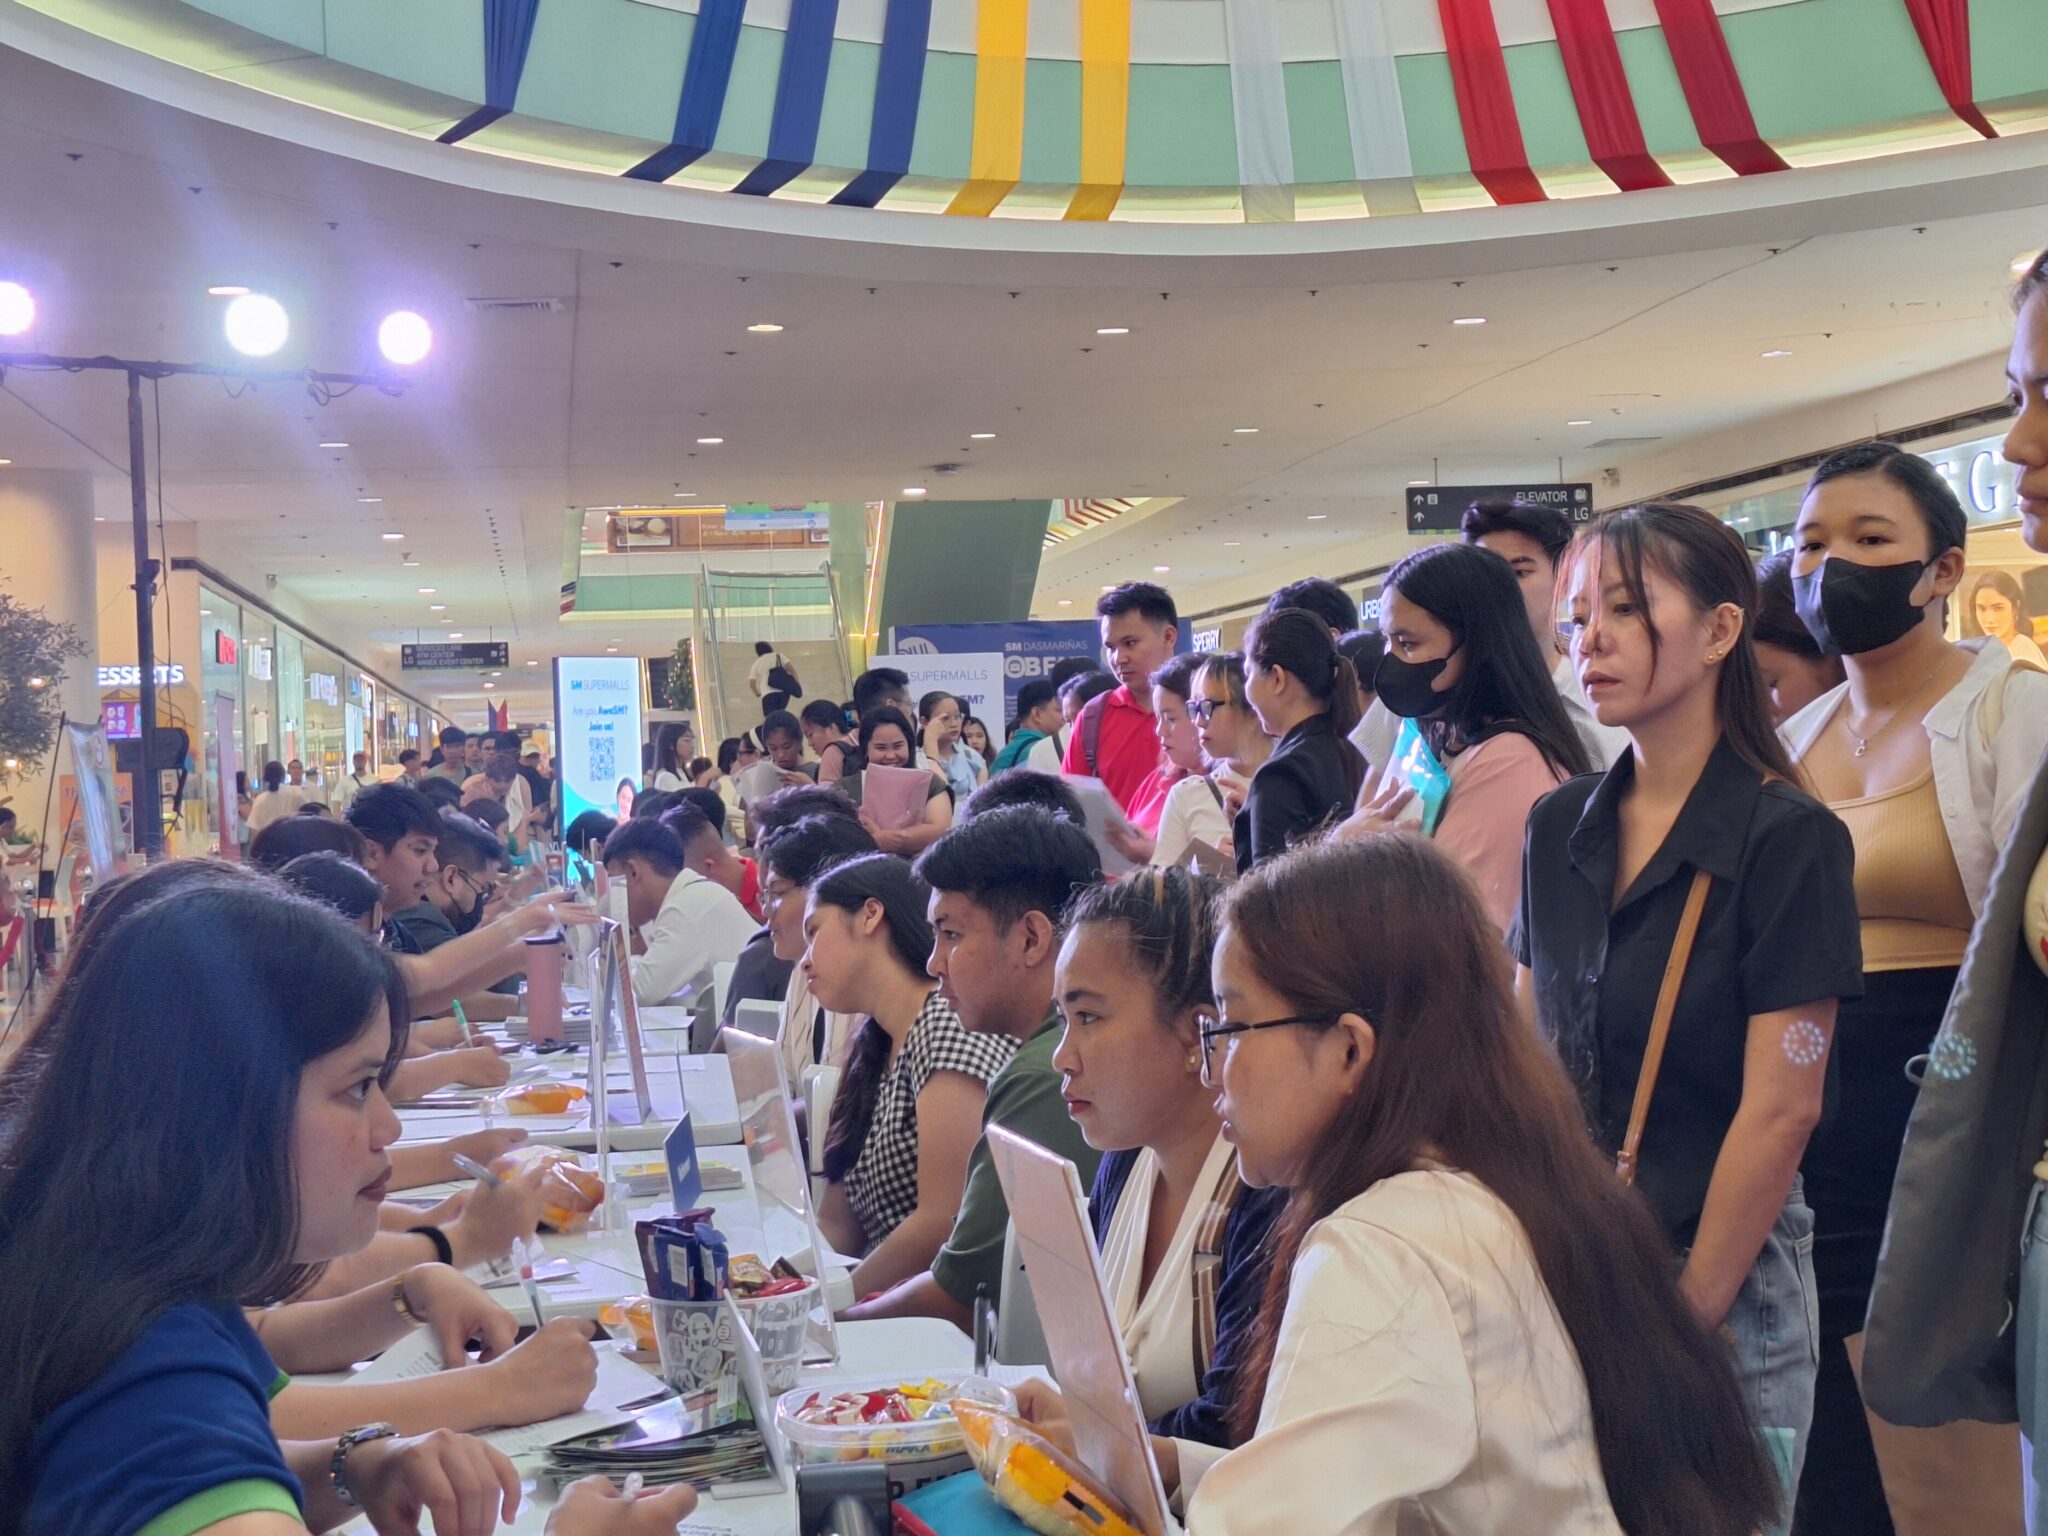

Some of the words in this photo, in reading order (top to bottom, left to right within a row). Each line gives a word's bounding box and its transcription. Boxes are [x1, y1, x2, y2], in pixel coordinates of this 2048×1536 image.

[1516, 490, 1568, 503] ELEVATOR
[1574, 507, 1589, 521] LG
[1005, 642, 1022, 652] SM
[1023, 639, 1088, 651] DASMARIÑAS
[460, 657, 483, 665] CENTER
[1004, 655, 1042, 679] OB
[98, 665, 184, 686] ESSETS
[910, 670, 988, 682] SUPERMALLS
[571, 680, 582, 690] SM
[583, 680, 630, 690] SUPERMALLS
[573, 704, 583, 715] Are
[589, 720, 602, 731] Join
